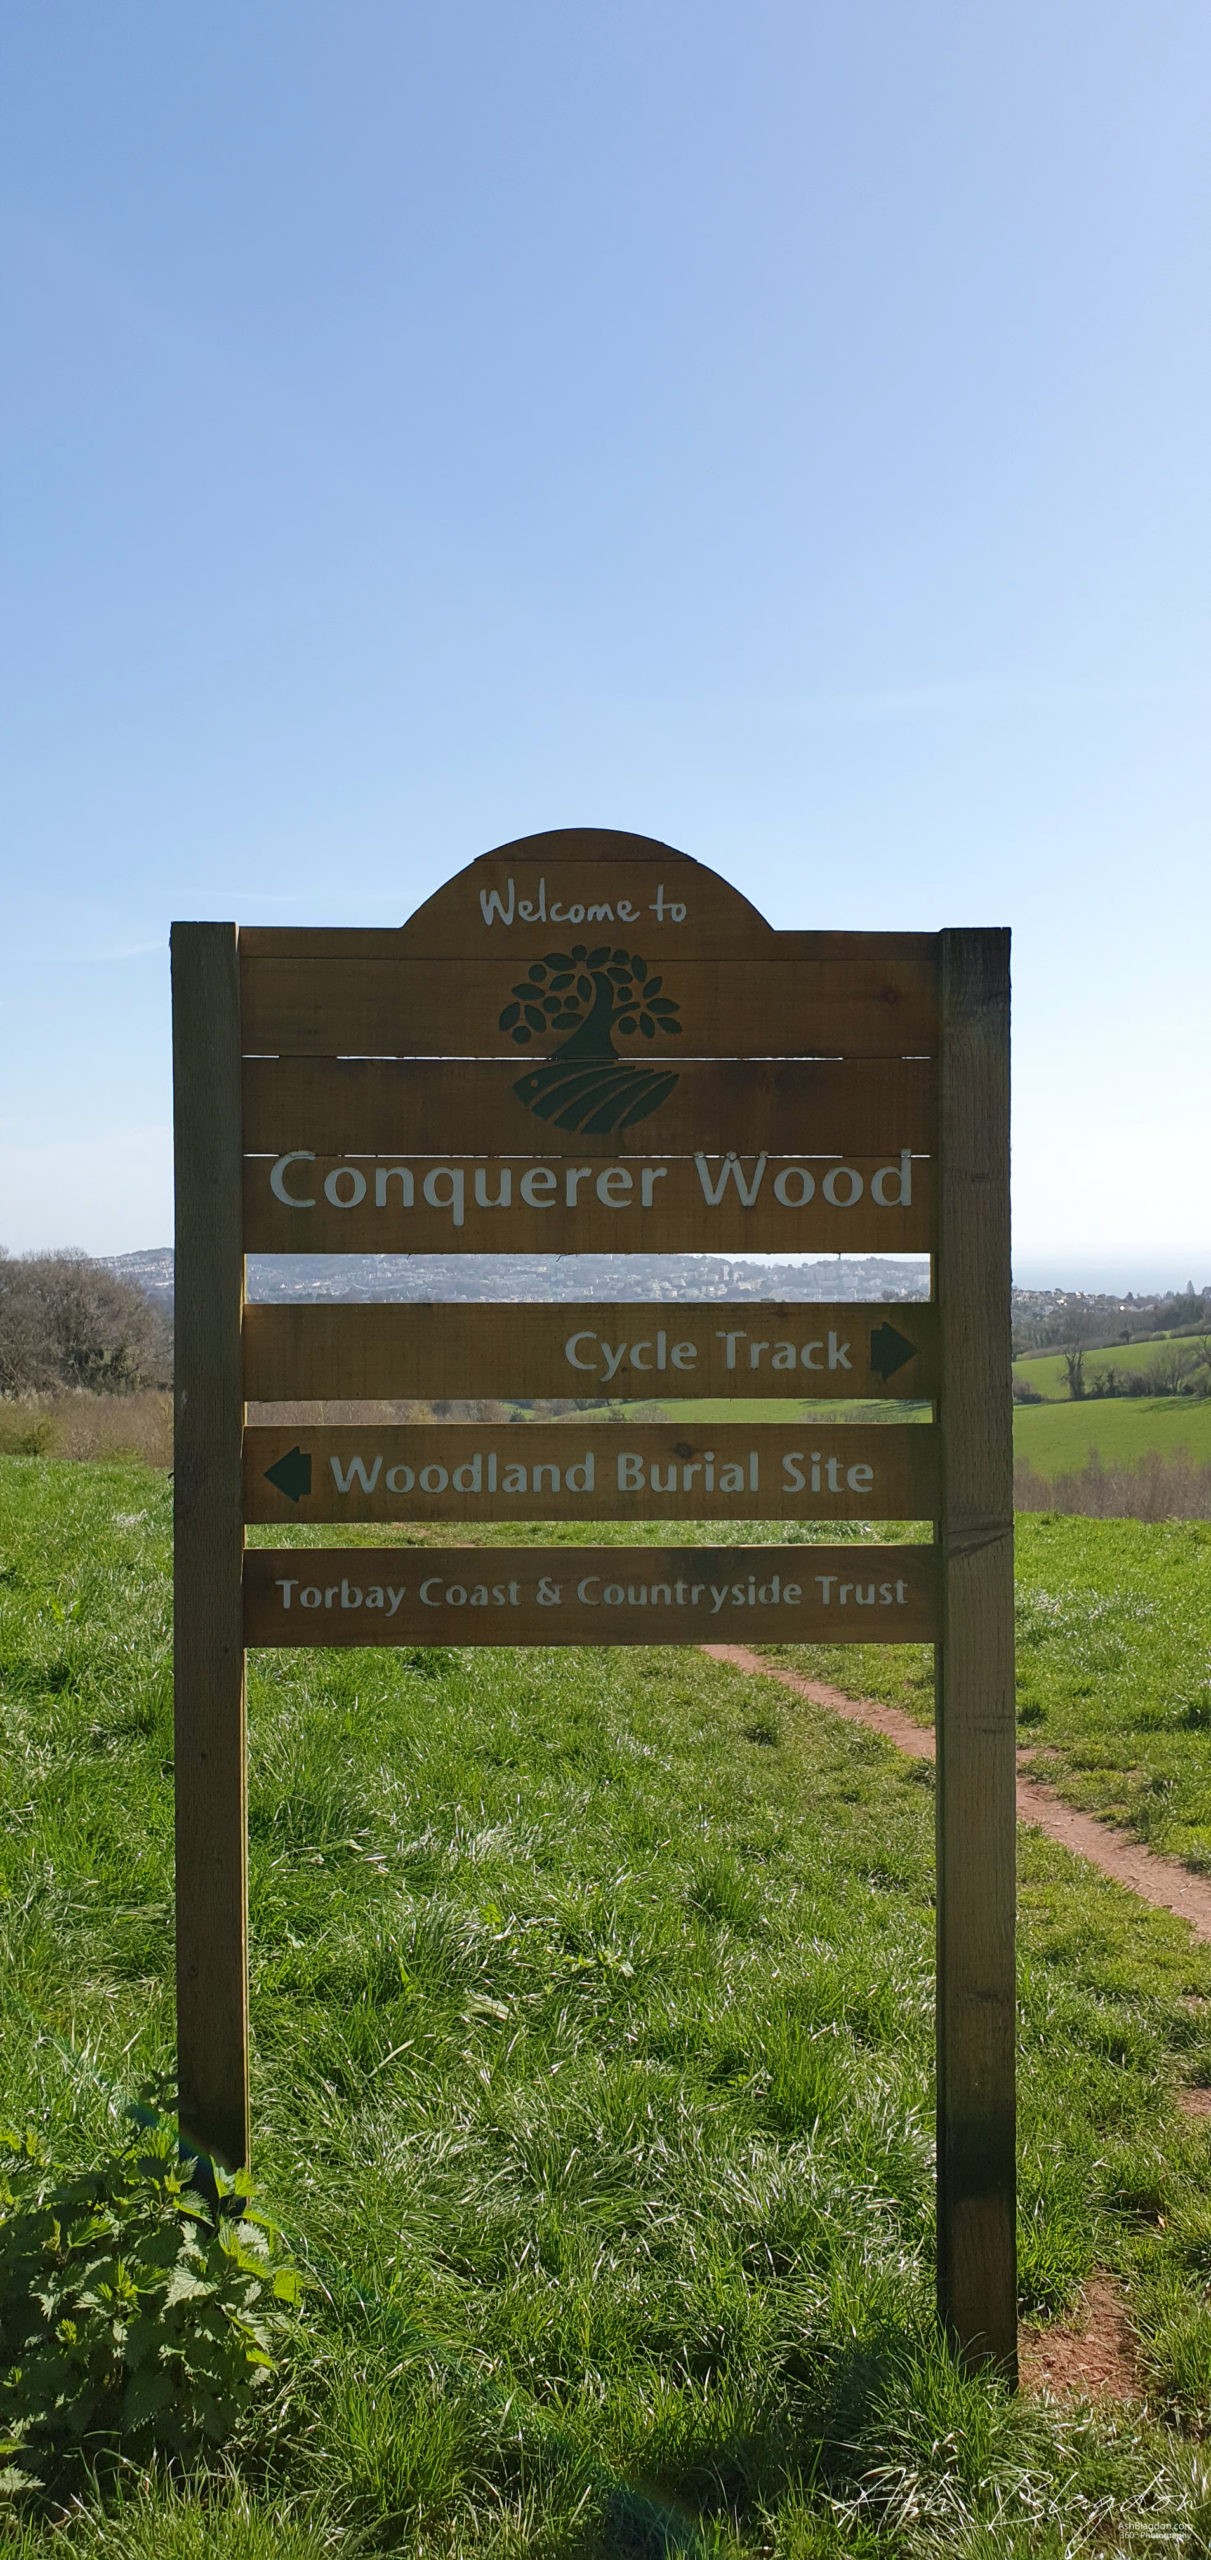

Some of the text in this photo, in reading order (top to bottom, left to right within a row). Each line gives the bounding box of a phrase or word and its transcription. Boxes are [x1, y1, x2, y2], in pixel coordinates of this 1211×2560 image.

[479, 877, 688, 926] Welcome to
[269, 1148, 913, 1227] Conquerer Wood
[564, 1330, 853, 1382] Cycle Track
[329, 1451, 875, 1494] Woodland Burial Site
[275, 1575, 909, 1617] Torbay Coast & Countryside Trust
